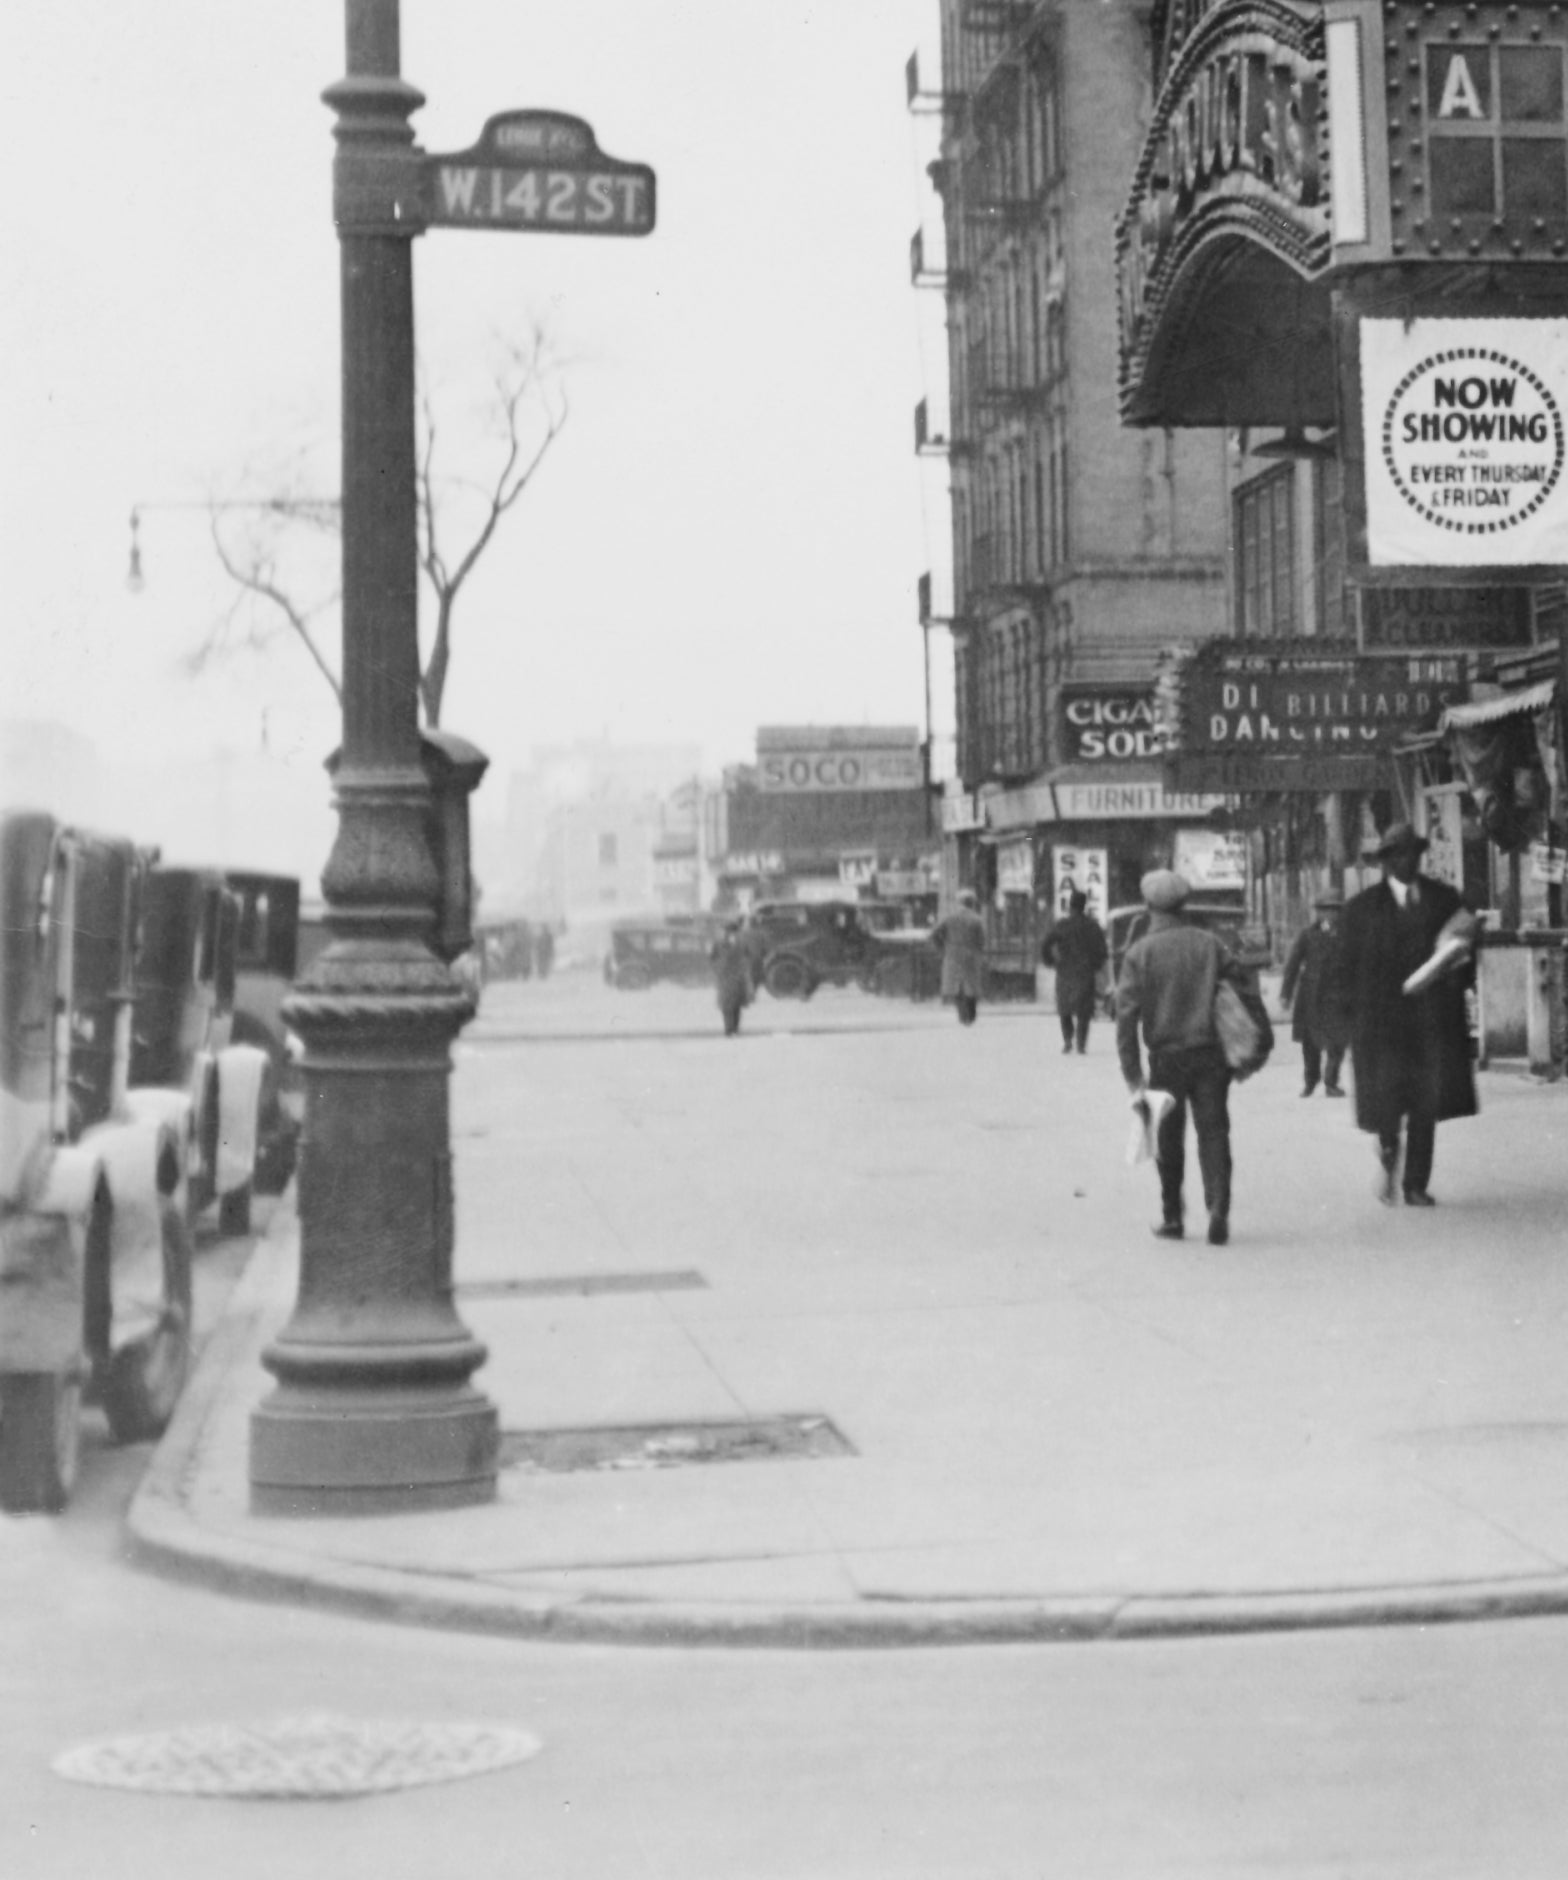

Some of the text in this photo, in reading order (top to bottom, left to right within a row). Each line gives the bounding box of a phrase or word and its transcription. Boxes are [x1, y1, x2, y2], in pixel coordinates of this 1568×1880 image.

[1437, 55, 1485, 119] A
[489, 168, 577, 221] 142
[1434, 377, 1517, 410] NOW
[1402, 412, 1548, 444] SHOWING
[1457, 449, 1490, 460] AND
[1410, 465, 1547, 484] EVERY THURSDAY
[1443, 487, 1511, 507] FRIDAY
